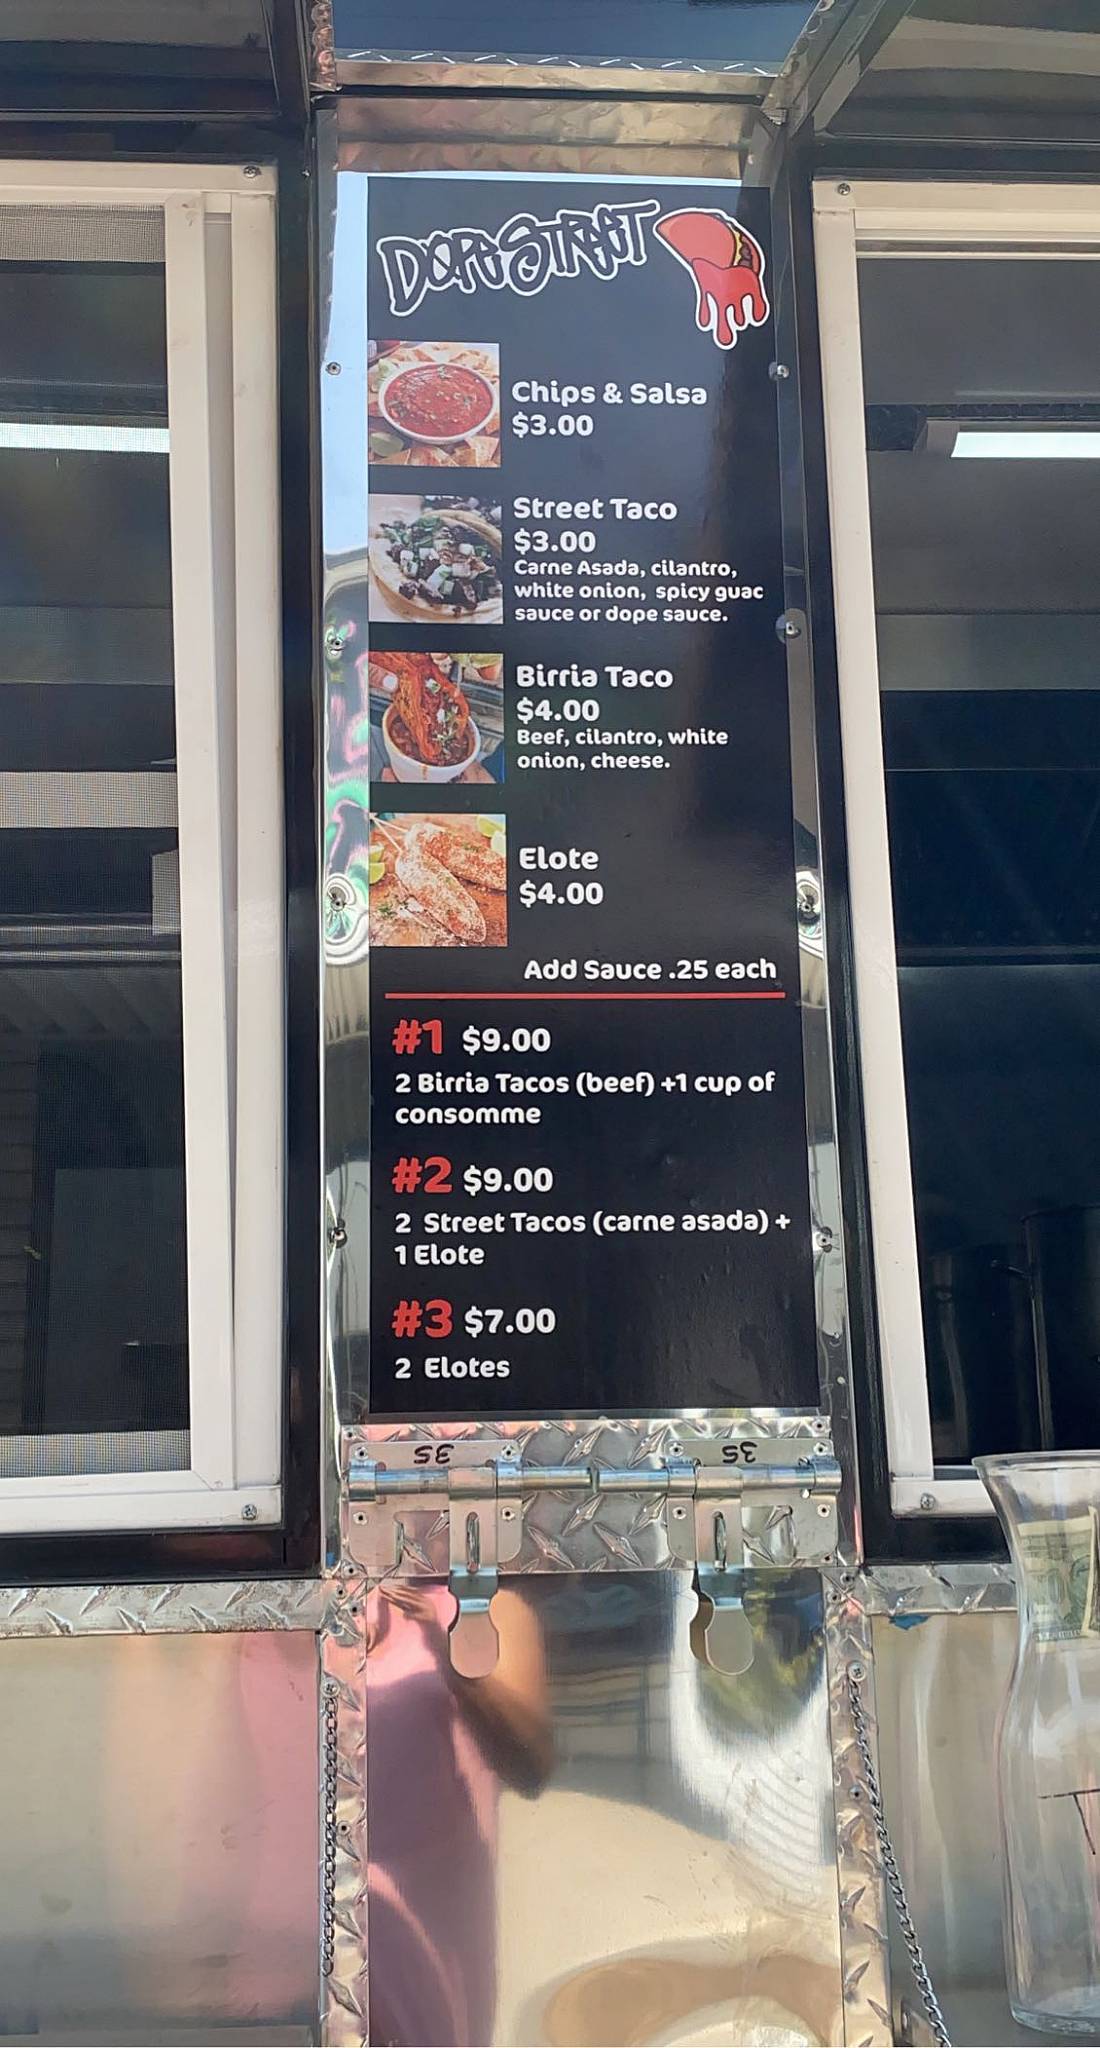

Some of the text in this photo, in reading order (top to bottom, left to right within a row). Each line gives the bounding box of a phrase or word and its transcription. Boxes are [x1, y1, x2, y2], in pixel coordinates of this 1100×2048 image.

[511, 381, 707, 408] Chips & Salsa
[512, 411, 594, 439] $3.00
[513, 496, 678, 520] Street Taco
[513, 527, 596, 556] $3.00
[514, 559, 737, 579] Carne Asada, cilantro,
[514, 581, 764, 603] white onion, spicy guac
[515, 605, 728, 625] sauce or dope sauce.
[516, 663, 674, 688] Birria Taco
[516, 696, 600, 725] $4.00
[517, 727, 729, 747] Beef, cilantro, white
[517, 751, 671, 771] onion, cheese.
[519, 846, 599, 870] Elote
[519, 879, 604, 908] $4.00
[524, 957, 777, 980] Add Sauce .25 each
[392, 1019, 551, 1056] #1 $9.00
[395, 1073, 411, 1093] 2
[418, 1071, 490, 1093] Birria
[494, 1073, 570, 1093] Tacos
[576, 1071, 655, 1097] (beef)
[694, 1075, 742, 1097] cup
[748, 1070, 776, 1092] of
[395, 1107, 541, 1124] consomme
[391, 1156, 554, 1197] #2 $9.00
[395, 1212, 412, 1234] 2
[423, 1212, 505, 1234] Street
[510, 1212, 586, 1233] Tacos
[592, 1210, 675, 1236] (carne
[681, 1209, 769, 1235] asada)
[394, 1243, 485, 1265] 1 Elote
[391, 1299, 556, 1338] #3 $7.00
[395, 1356, 510, 1379] 2 Elotes
